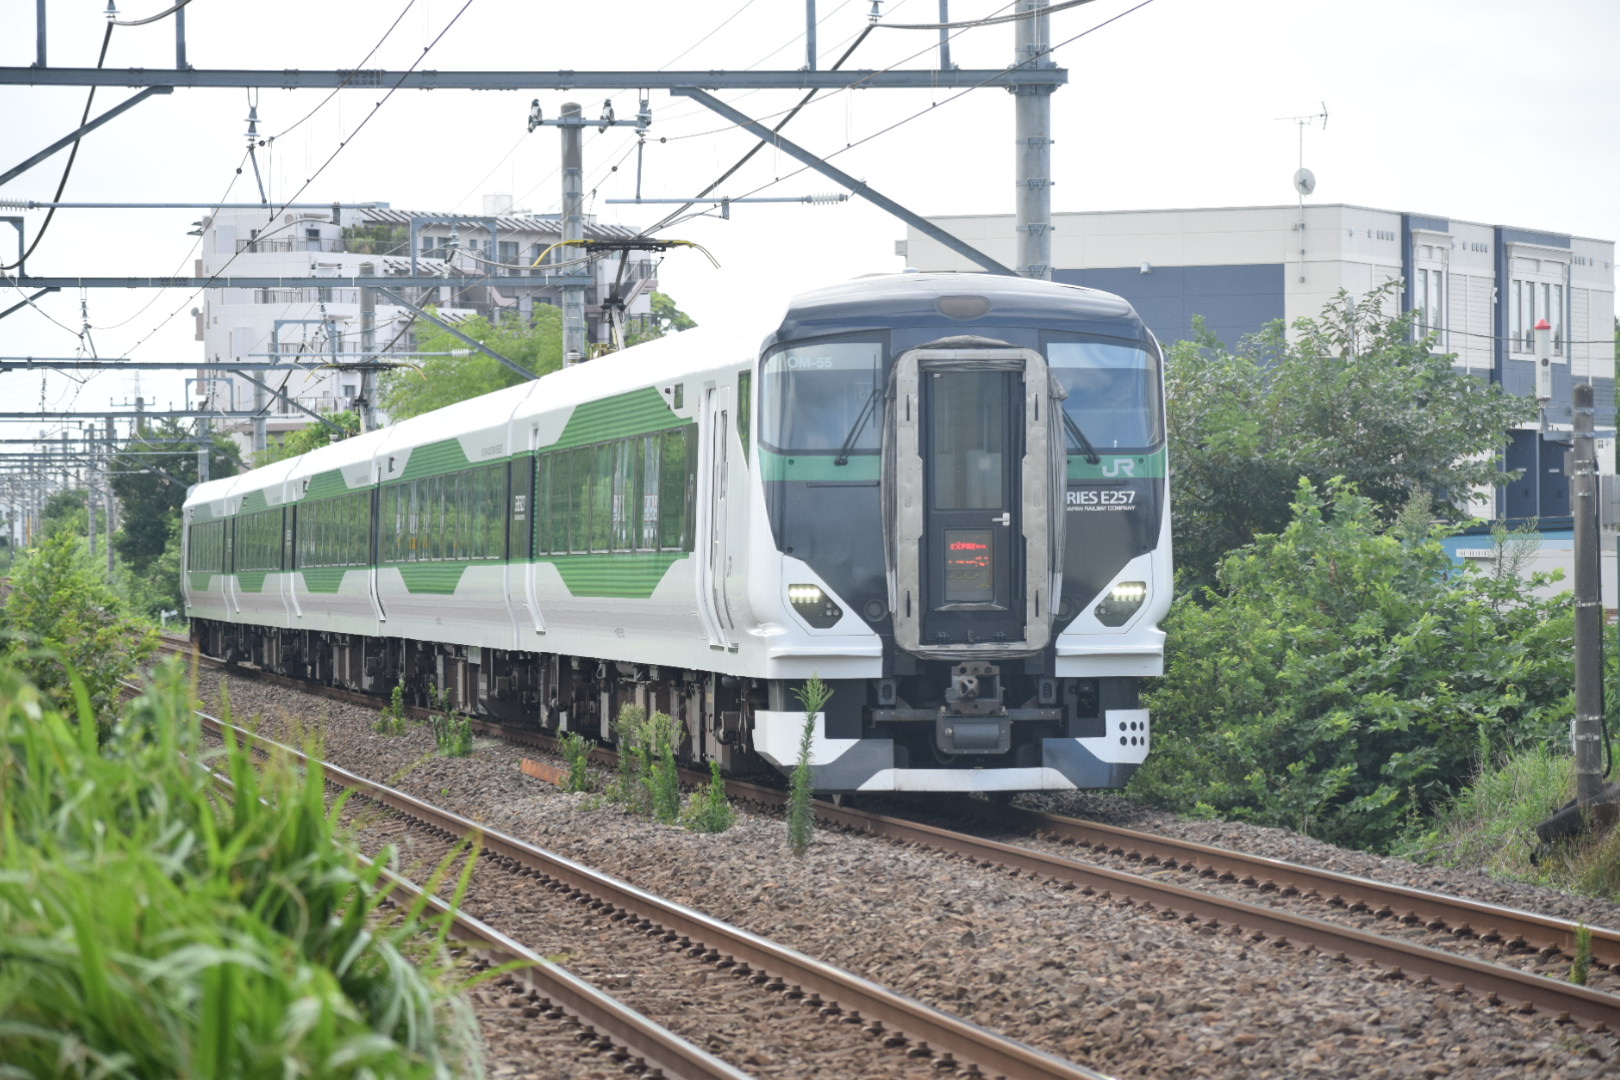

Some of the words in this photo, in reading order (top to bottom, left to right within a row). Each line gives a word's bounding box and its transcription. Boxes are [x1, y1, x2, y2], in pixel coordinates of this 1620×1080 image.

[787, 356, 833, 369] OM-55
[1102, 458, 1135, 477] JR
[1101, 491, 1136, 504] E257
